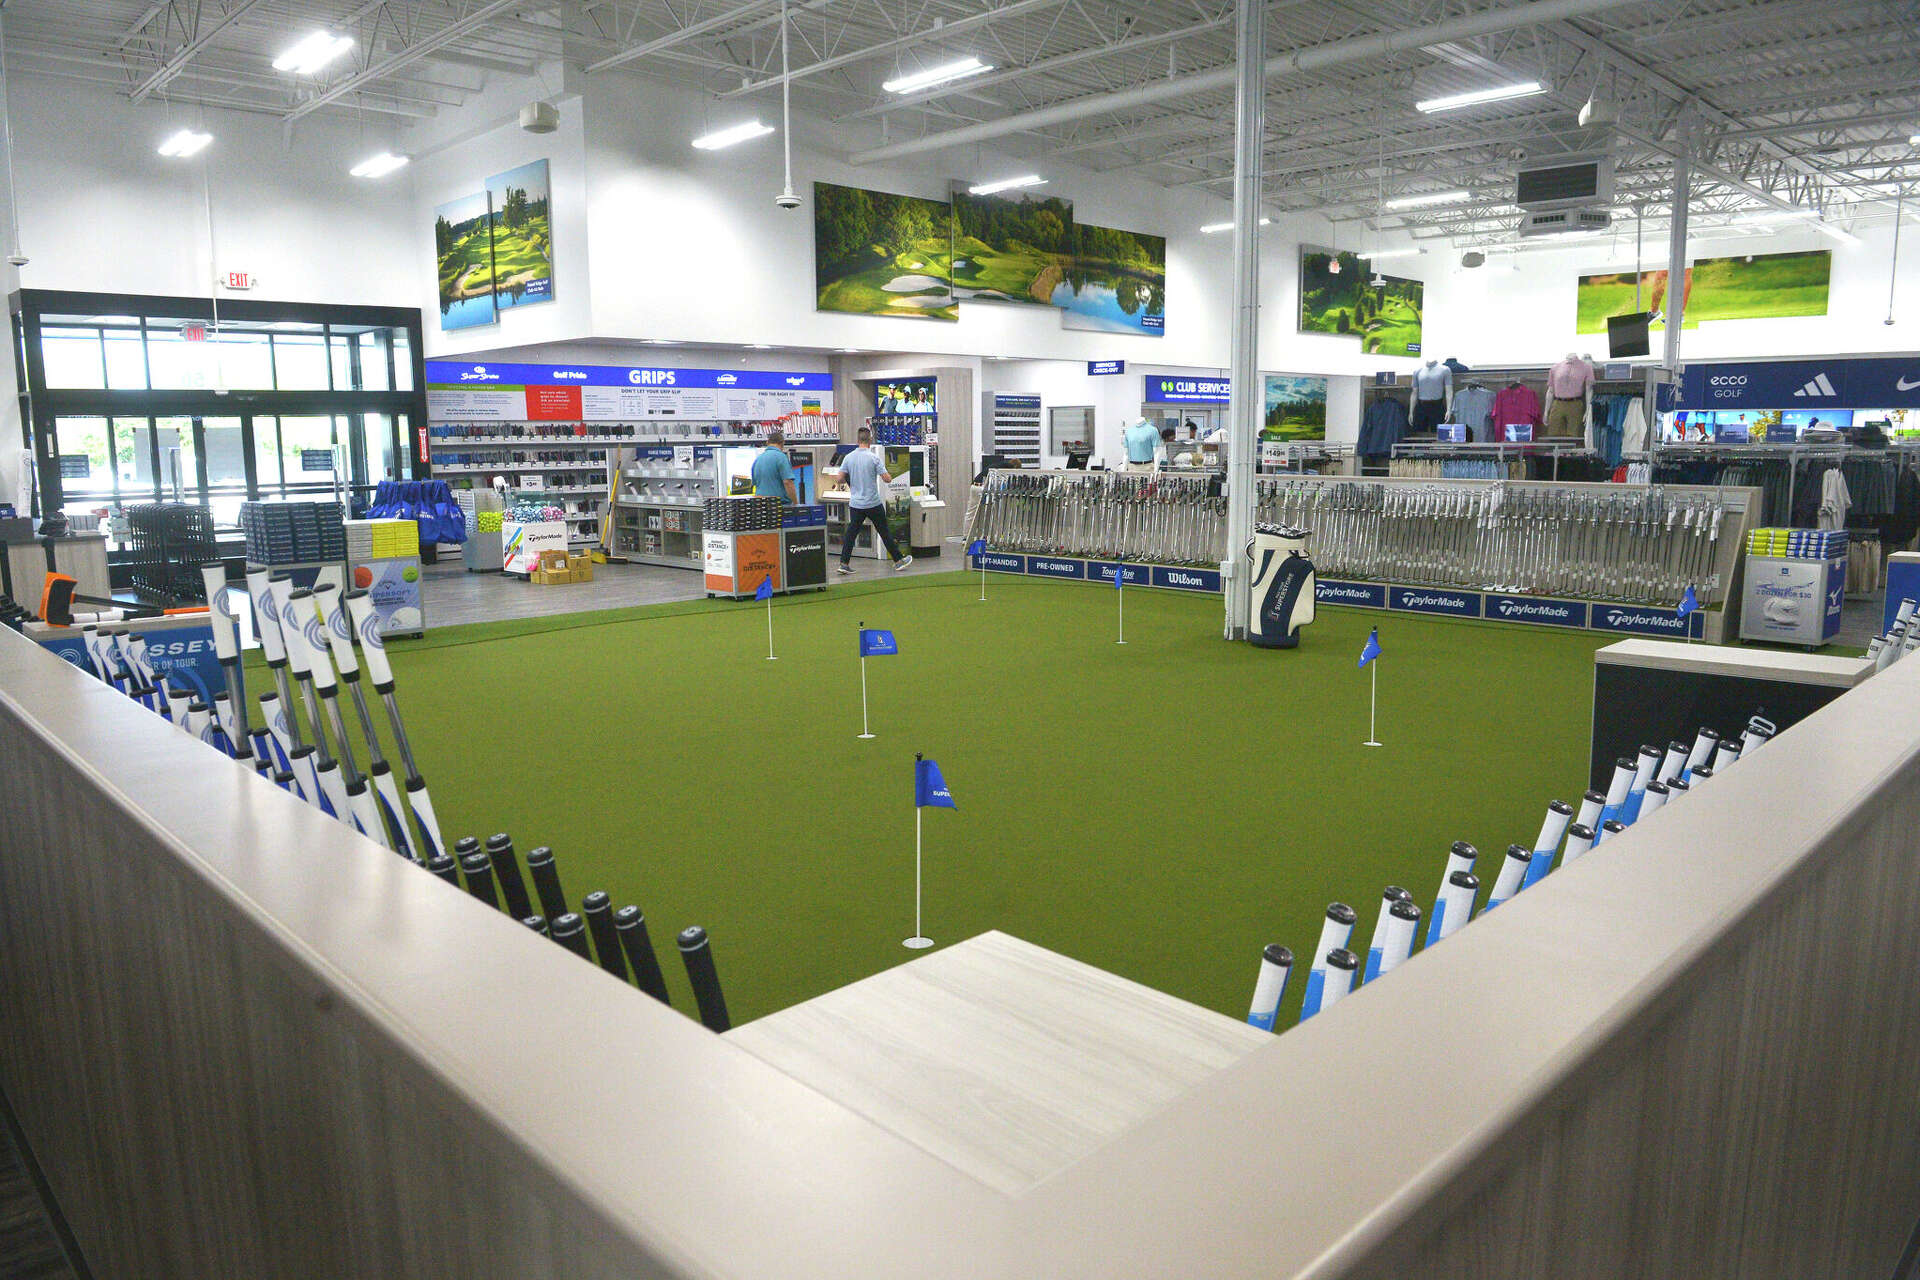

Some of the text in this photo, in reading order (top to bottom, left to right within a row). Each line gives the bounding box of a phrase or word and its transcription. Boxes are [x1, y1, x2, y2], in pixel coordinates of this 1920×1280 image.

[230, 272, 248, 287] EXIT
[187, 327, 204, 341] EXIT
[552, 371, 587, 380] Golf Pride
[628, 370, 676, 385] GRIPS
[1711, 376, 1748, 386] ecco
[1176, 382, 1230, 394] CLUB SERVICE
[1714, 389, 1743, 398] GOLF
[528, 533, 562, 542] TaylorMade
[789, 544, 821, 554] TaylorMade
[978, 557, 1018, 567] LFT-HANDED
[1036, 562, 1074, 572] PRE-OWNED
[1168, 572, 1203, 586] Wilson
[1316, 584, 1371, 600] TaylorMade
[1402, 592, 1465, 608] TaylorMade
[1499, 600, 1569, 617] TaylorMade
[1607, 610, 1684, 628] TaylorMade
[149, 639, 216, 657] SSEY
